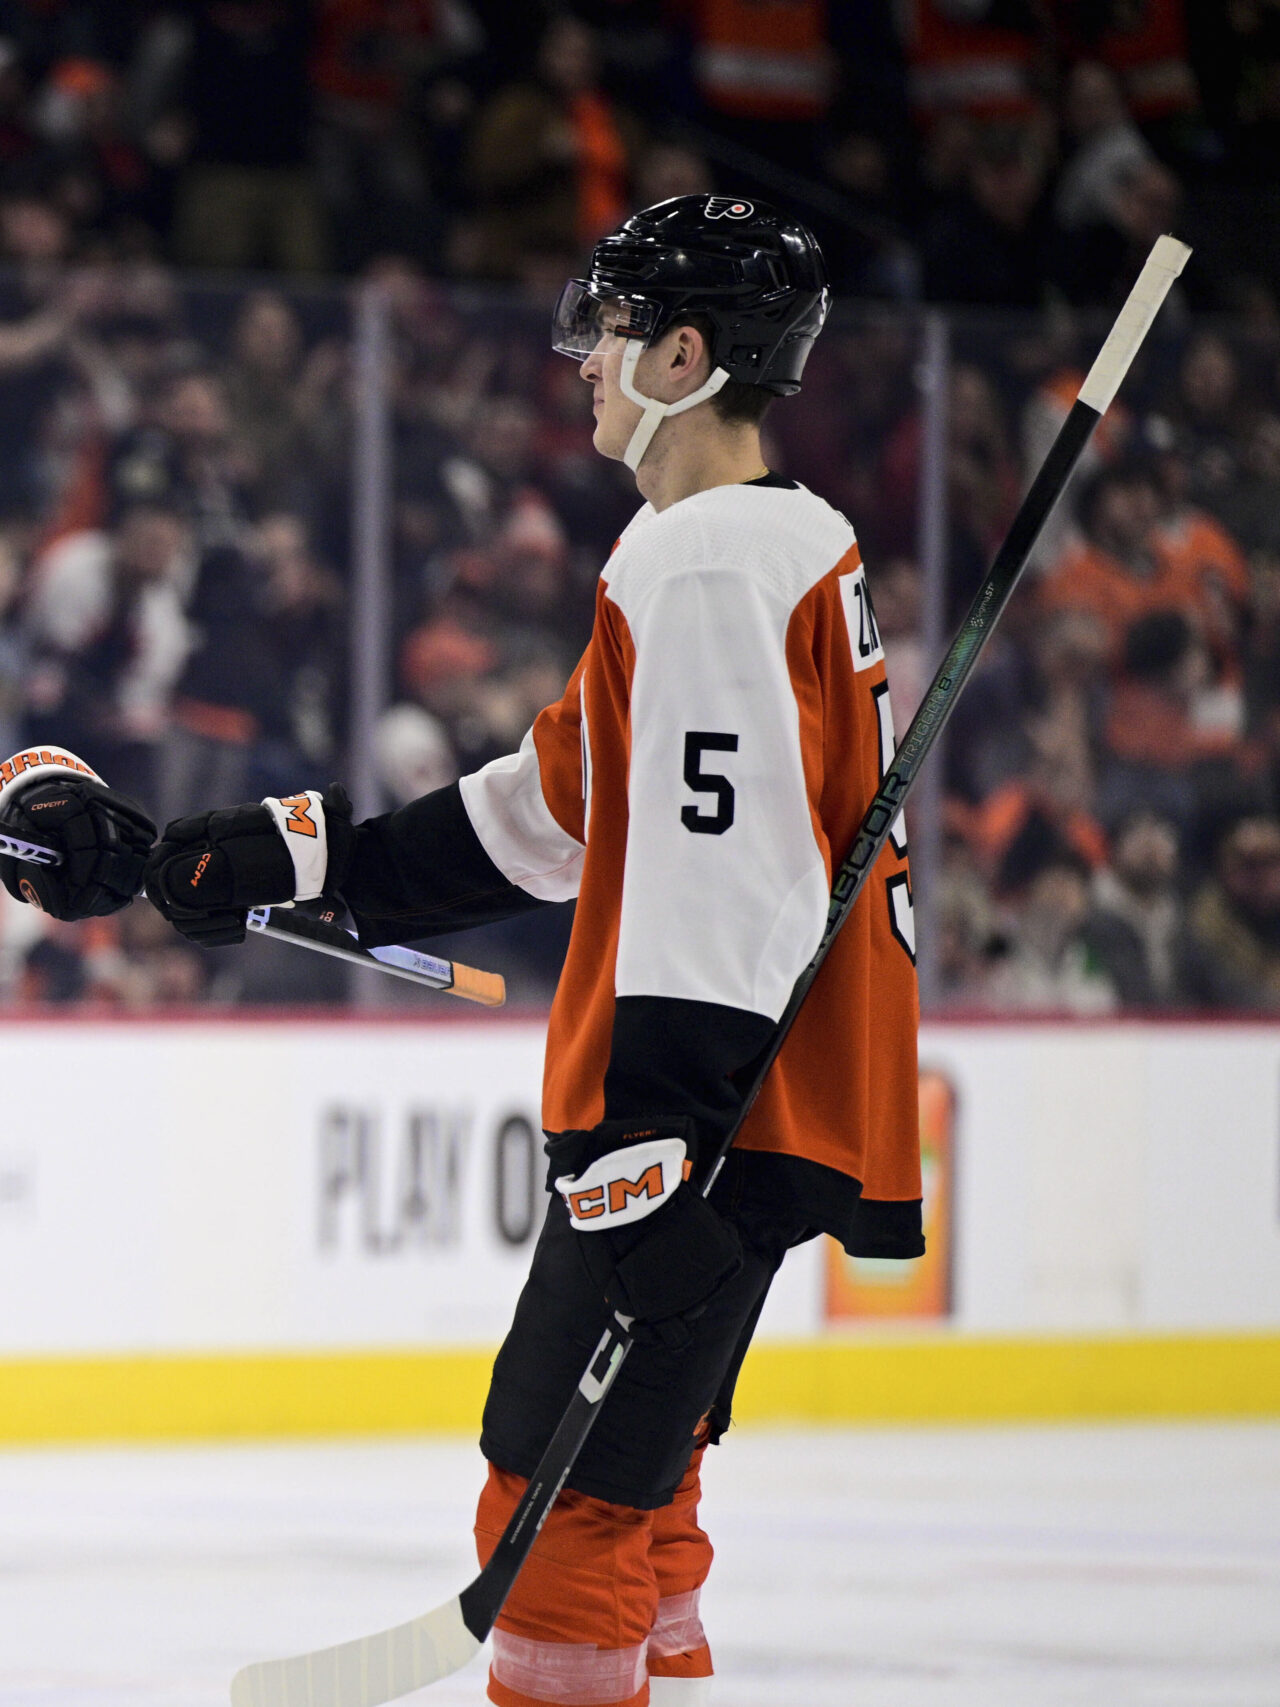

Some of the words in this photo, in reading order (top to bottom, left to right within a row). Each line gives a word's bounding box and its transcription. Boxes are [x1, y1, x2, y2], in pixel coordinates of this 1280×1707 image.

[901, 690, 946, 766] TRIGGER
[31, 799, 68, 811] COVERT
[681, 731, 739, 836] 5
[190, 853, 211, 888] CCM
[317, 1106, 476, 1256] PLAY
[562, 1162, 665, 1220] CM
